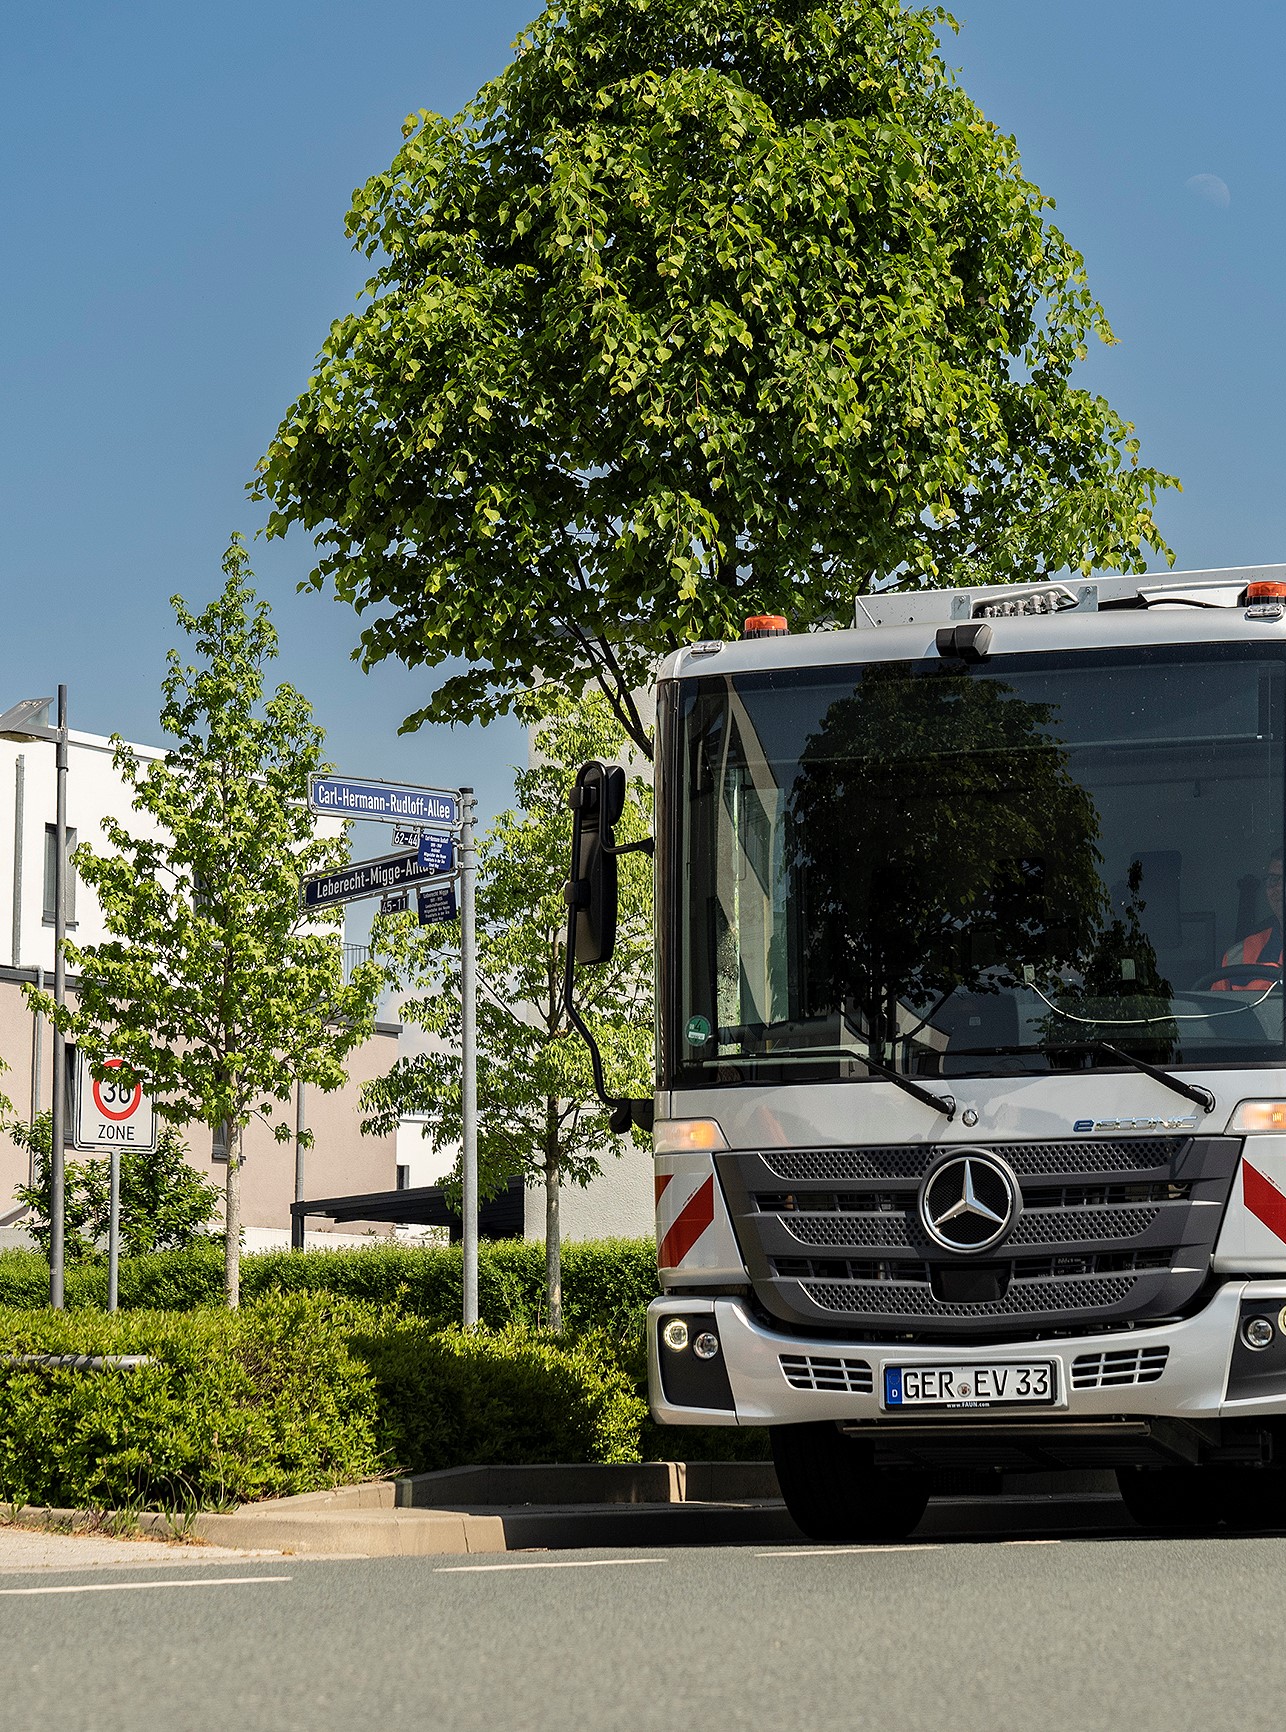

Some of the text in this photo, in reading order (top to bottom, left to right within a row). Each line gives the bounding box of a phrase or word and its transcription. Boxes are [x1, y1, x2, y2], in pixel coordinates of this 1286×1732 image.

[318, 784, 451, 819] Carl-Hermann-Rudloff-Allee
[394, 832, 420, 847] 62-44
[382, 897, 407, 914] 45-11
[98, 1124, 135, 1141] ZONE
[891, 1368, 1048, 1399] D GER EV 33
[946, 1401, 990, 1409] www.FAUN.com
